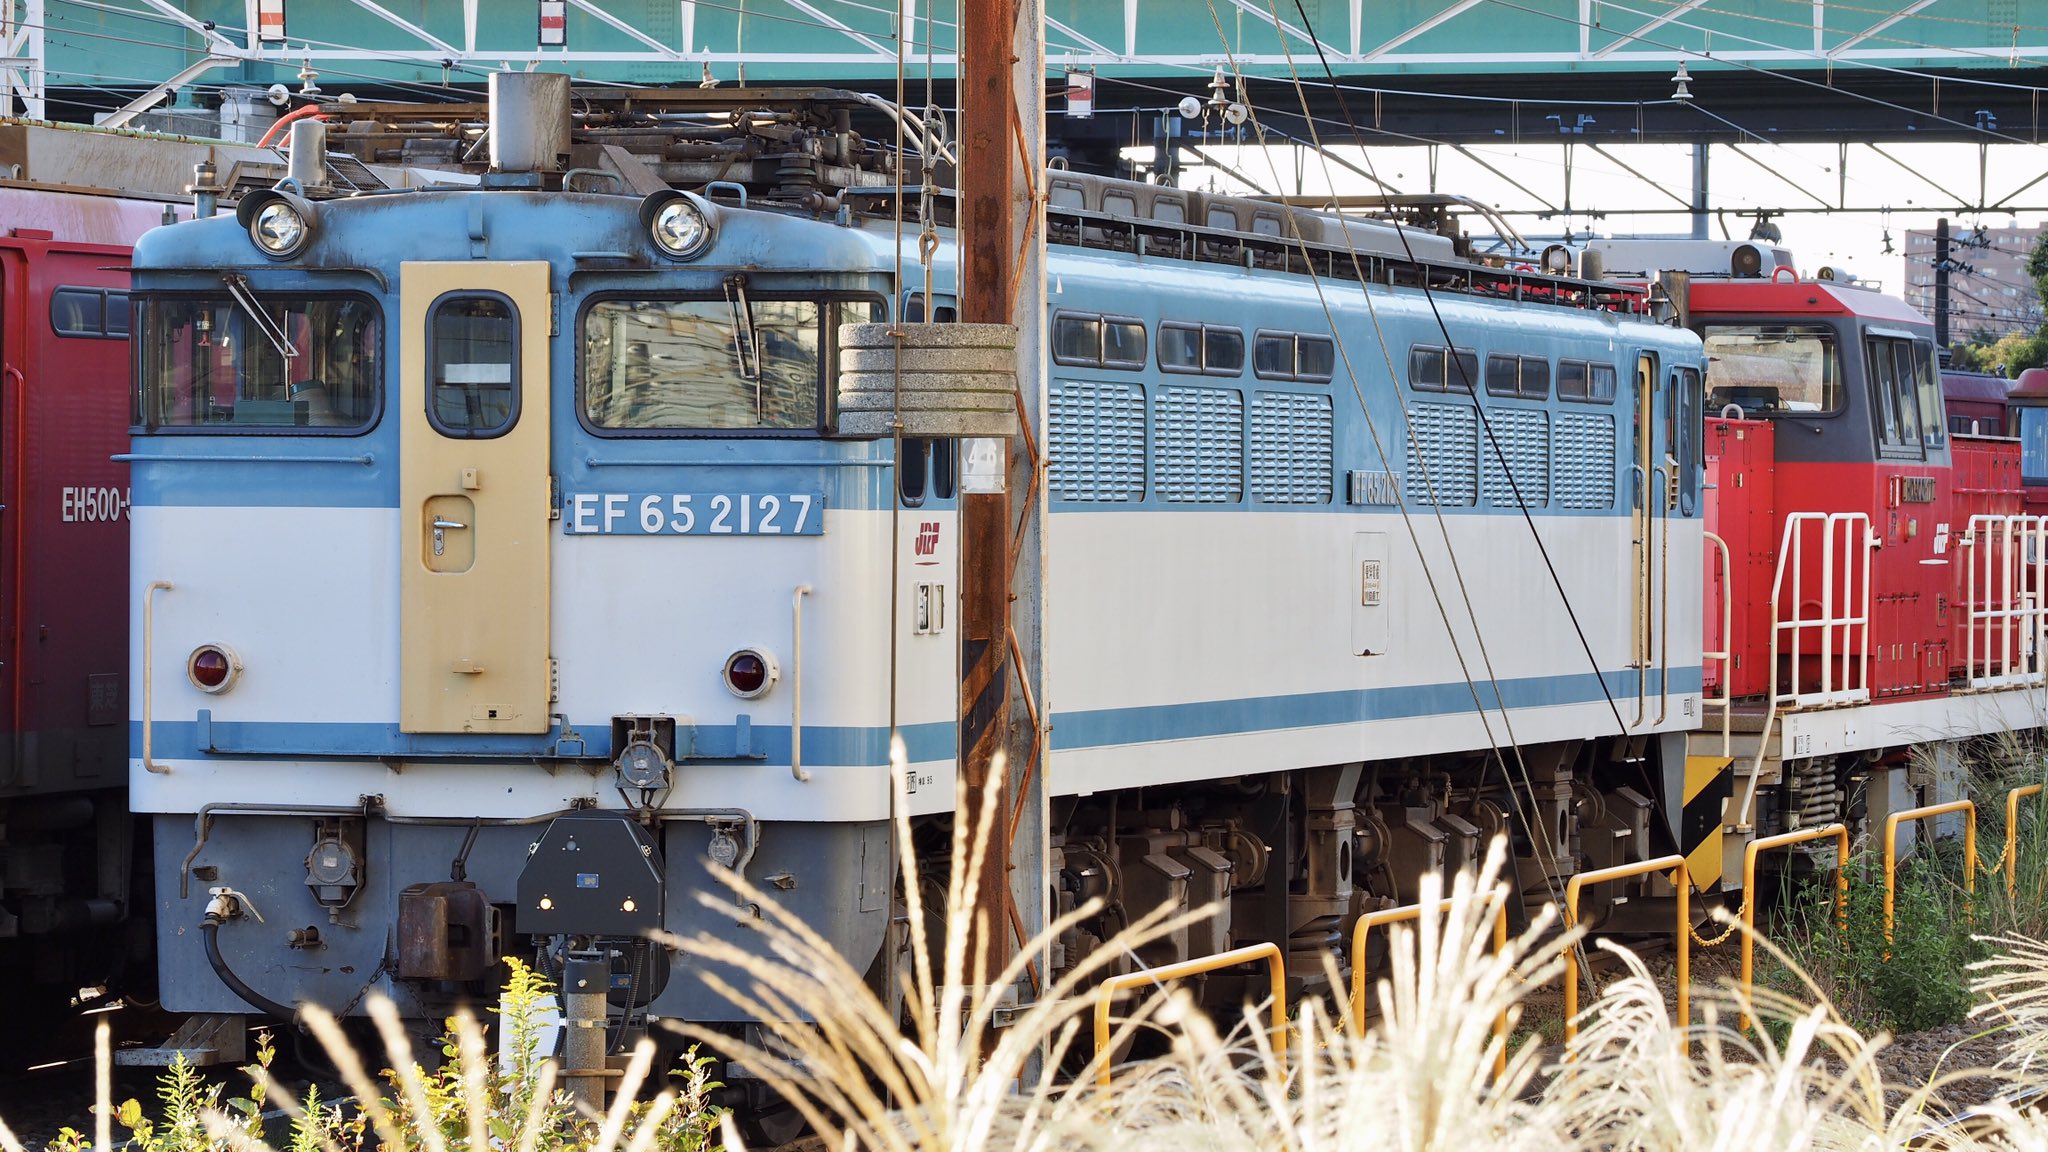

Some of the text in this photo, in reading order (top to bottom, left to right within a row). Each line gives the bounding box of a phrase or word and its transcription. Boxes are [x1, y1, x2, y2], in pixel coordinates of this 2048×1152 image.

[574, 494, 812, 534] EF 65 2127
